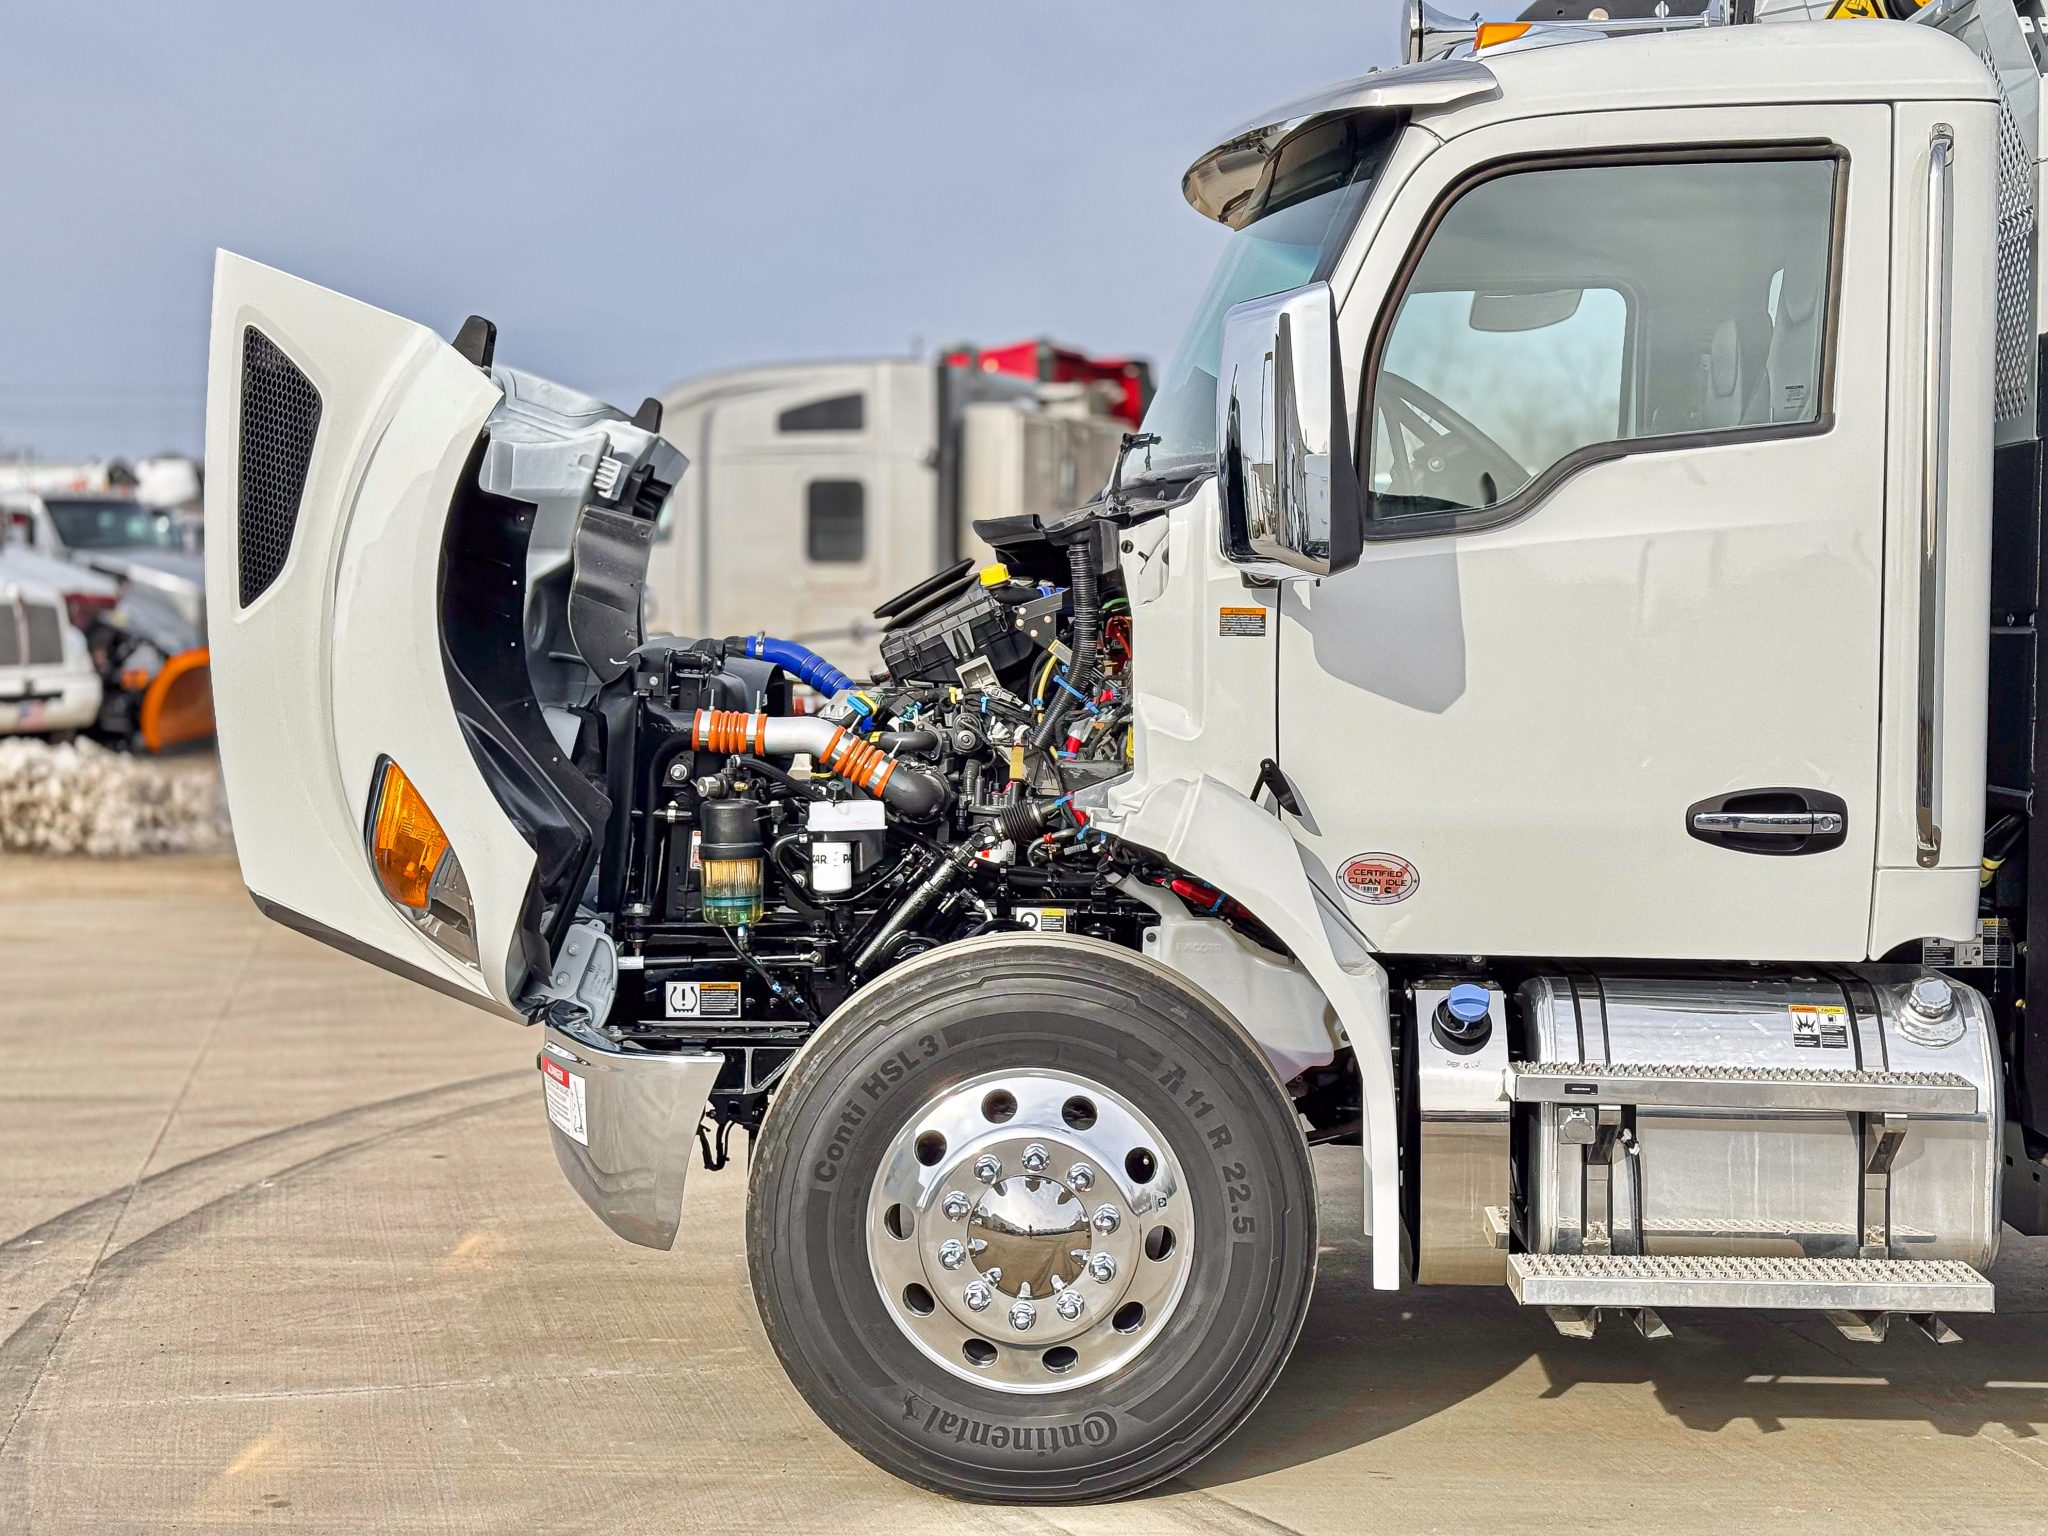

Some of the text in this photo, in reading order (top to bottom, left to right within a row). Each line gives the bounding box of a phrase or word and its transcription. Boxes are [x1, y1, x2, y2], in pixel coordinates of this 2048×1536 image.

[1348, 877, 1407, 887] CLEAN IDLE
[1353, 868, 1403, 878] CERTIFIED
[814, 1034, 940, 1182] Conti HSL 3
[1184, 1089, 1256, 1235] 11 R 22.5
[921, 1404, 1119, 1457] Continental
